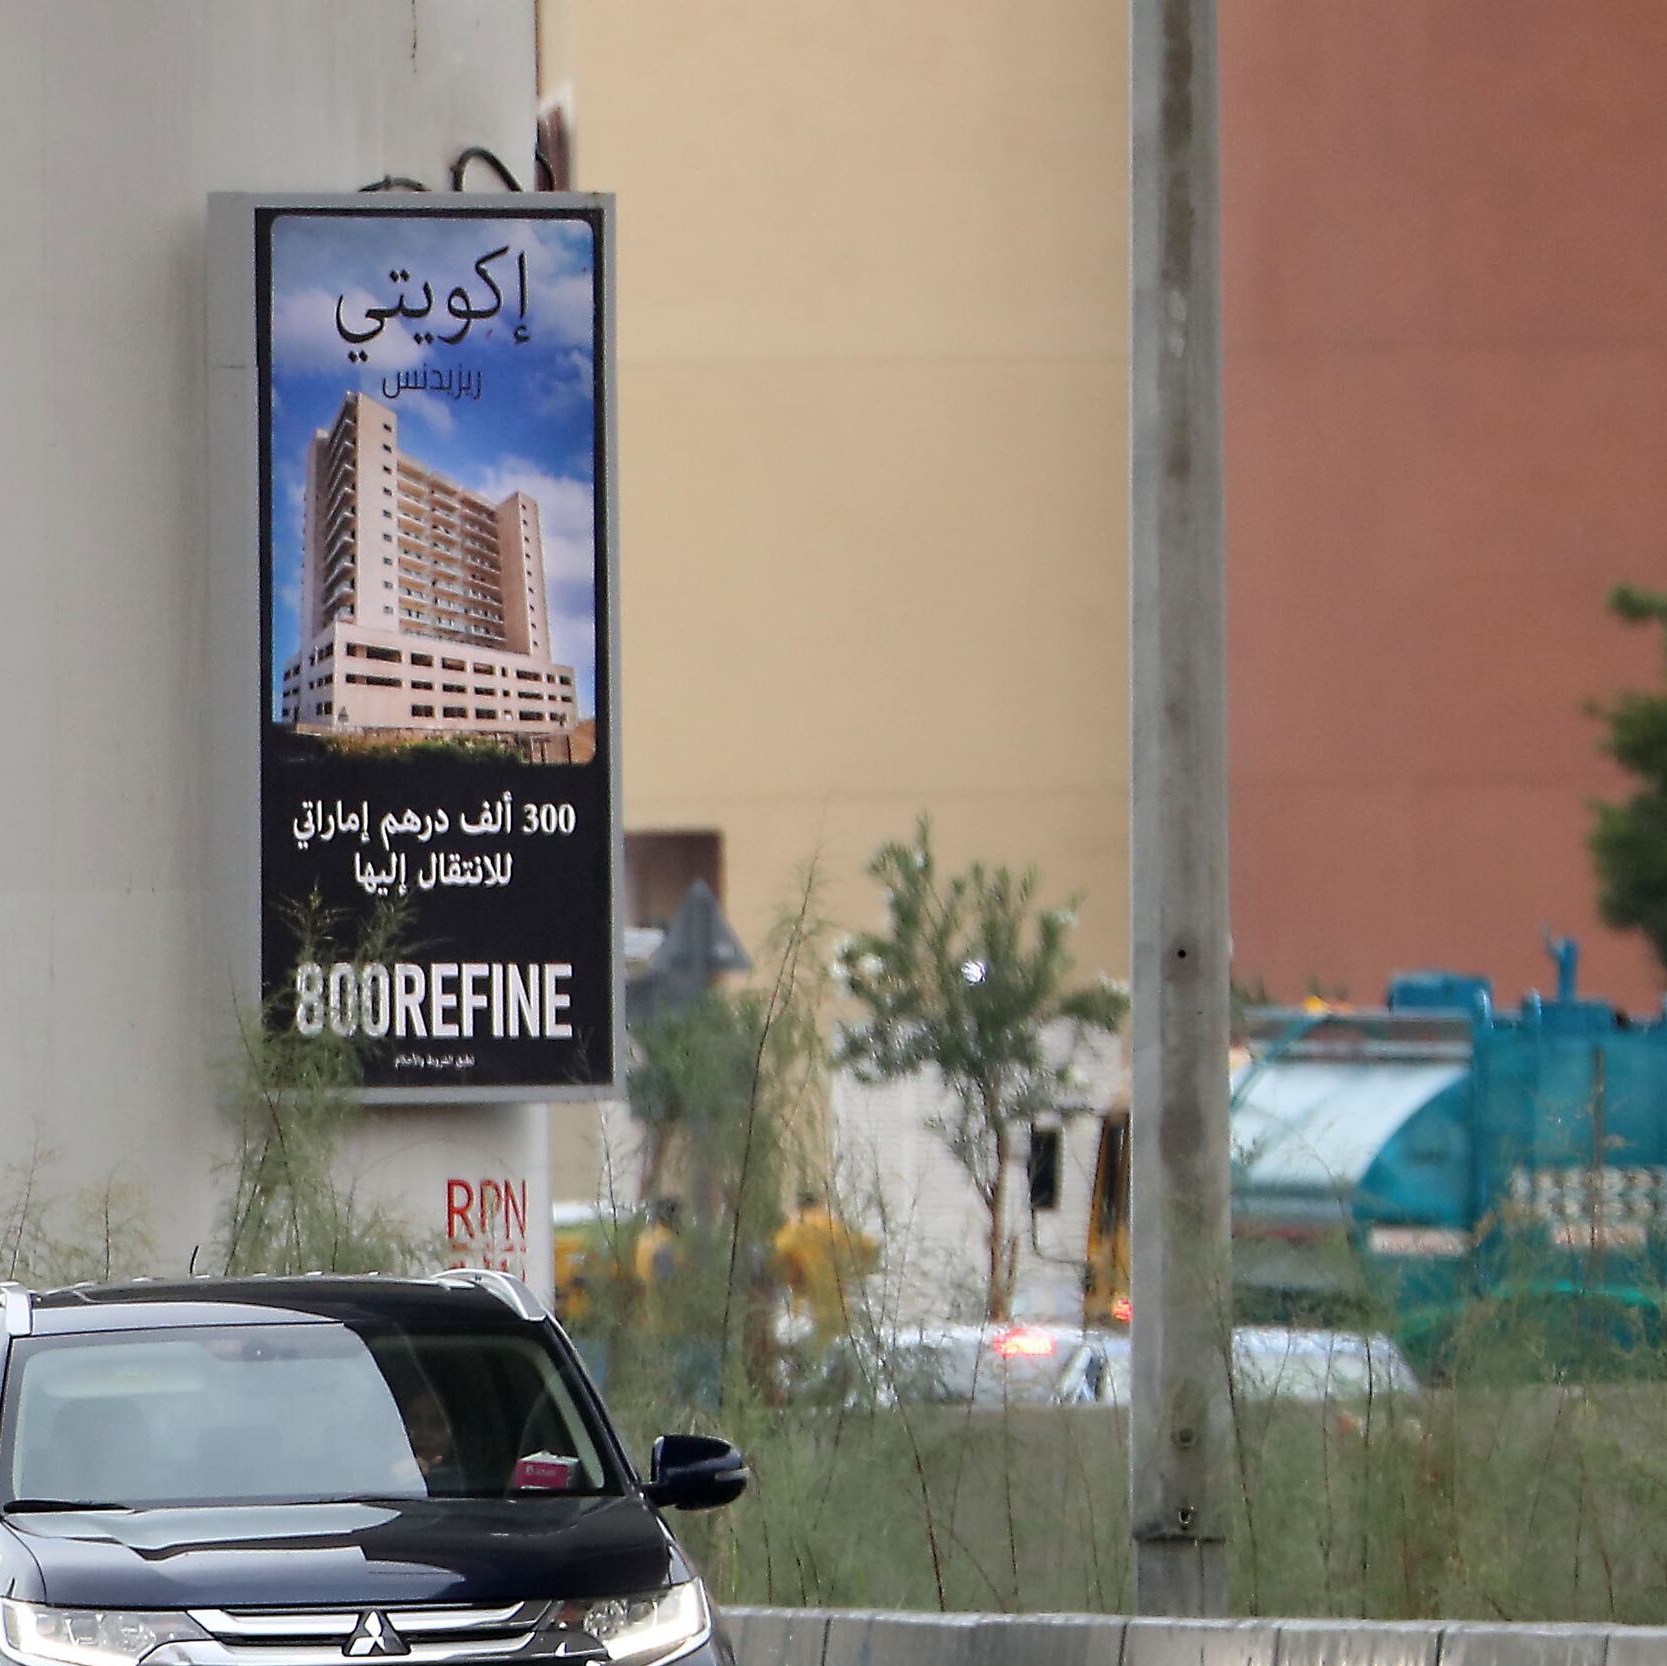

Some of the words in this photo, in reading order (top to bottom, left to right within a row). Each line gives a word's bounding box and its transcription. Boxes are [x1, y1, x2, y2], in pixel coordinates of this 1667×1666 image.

[335, 245, 531, 364] إكويتي
[292, 799, 371, 850] إماراتي
[381, 808, 450, 851] درهم
[460, 790, 513, 834] ألف
[522, 803, 577, 835] 300
[354, 851, 409, 897] إليها
[418, 852, 513, 890] للانتقال
[295, 961, 574, 1039] 800REFINE
[447, 1178, 527, 1239] RPN
